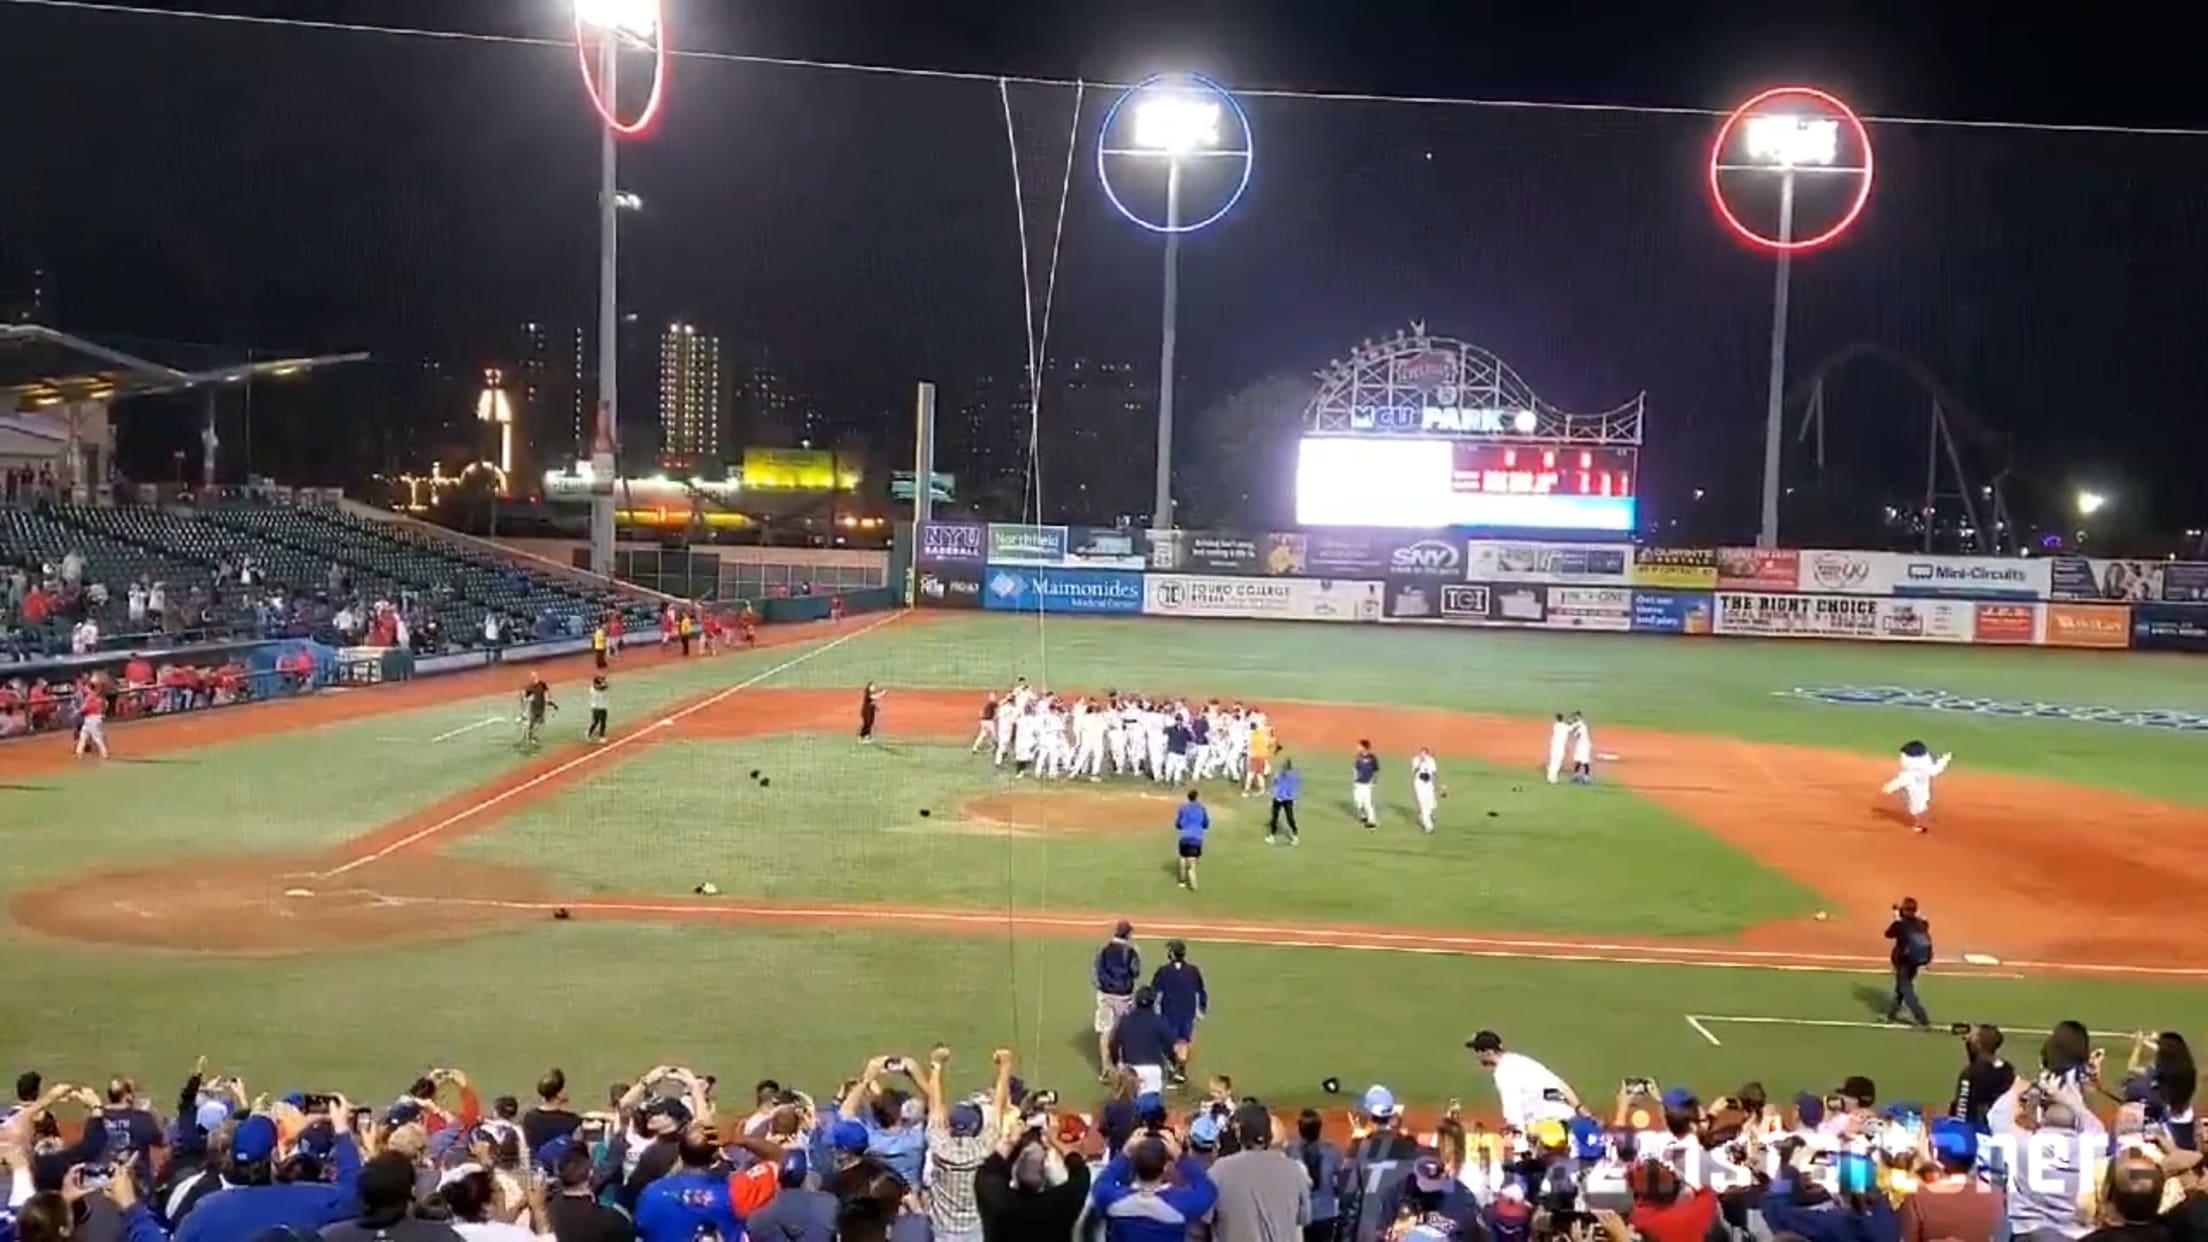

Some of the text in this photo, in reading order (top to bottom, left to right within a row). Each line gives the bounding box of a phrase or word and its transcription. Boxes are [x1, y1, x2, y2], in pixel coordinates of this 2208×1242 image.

[1422, 407, 1504, 431] PARK
[923, 525, 981, 547] NYU
[994, 531, 1059, 546] Northfield
[924, 546, 979, 556] BASEBALL
[1391, 547, 1450, 566] SNY
[1936, 566, 2026, 582] Mini-Circuits
[1032, 578, 1139, 597] Maimonides
[1720, 595, 1878, 615] THE RIGHT CHOICE
